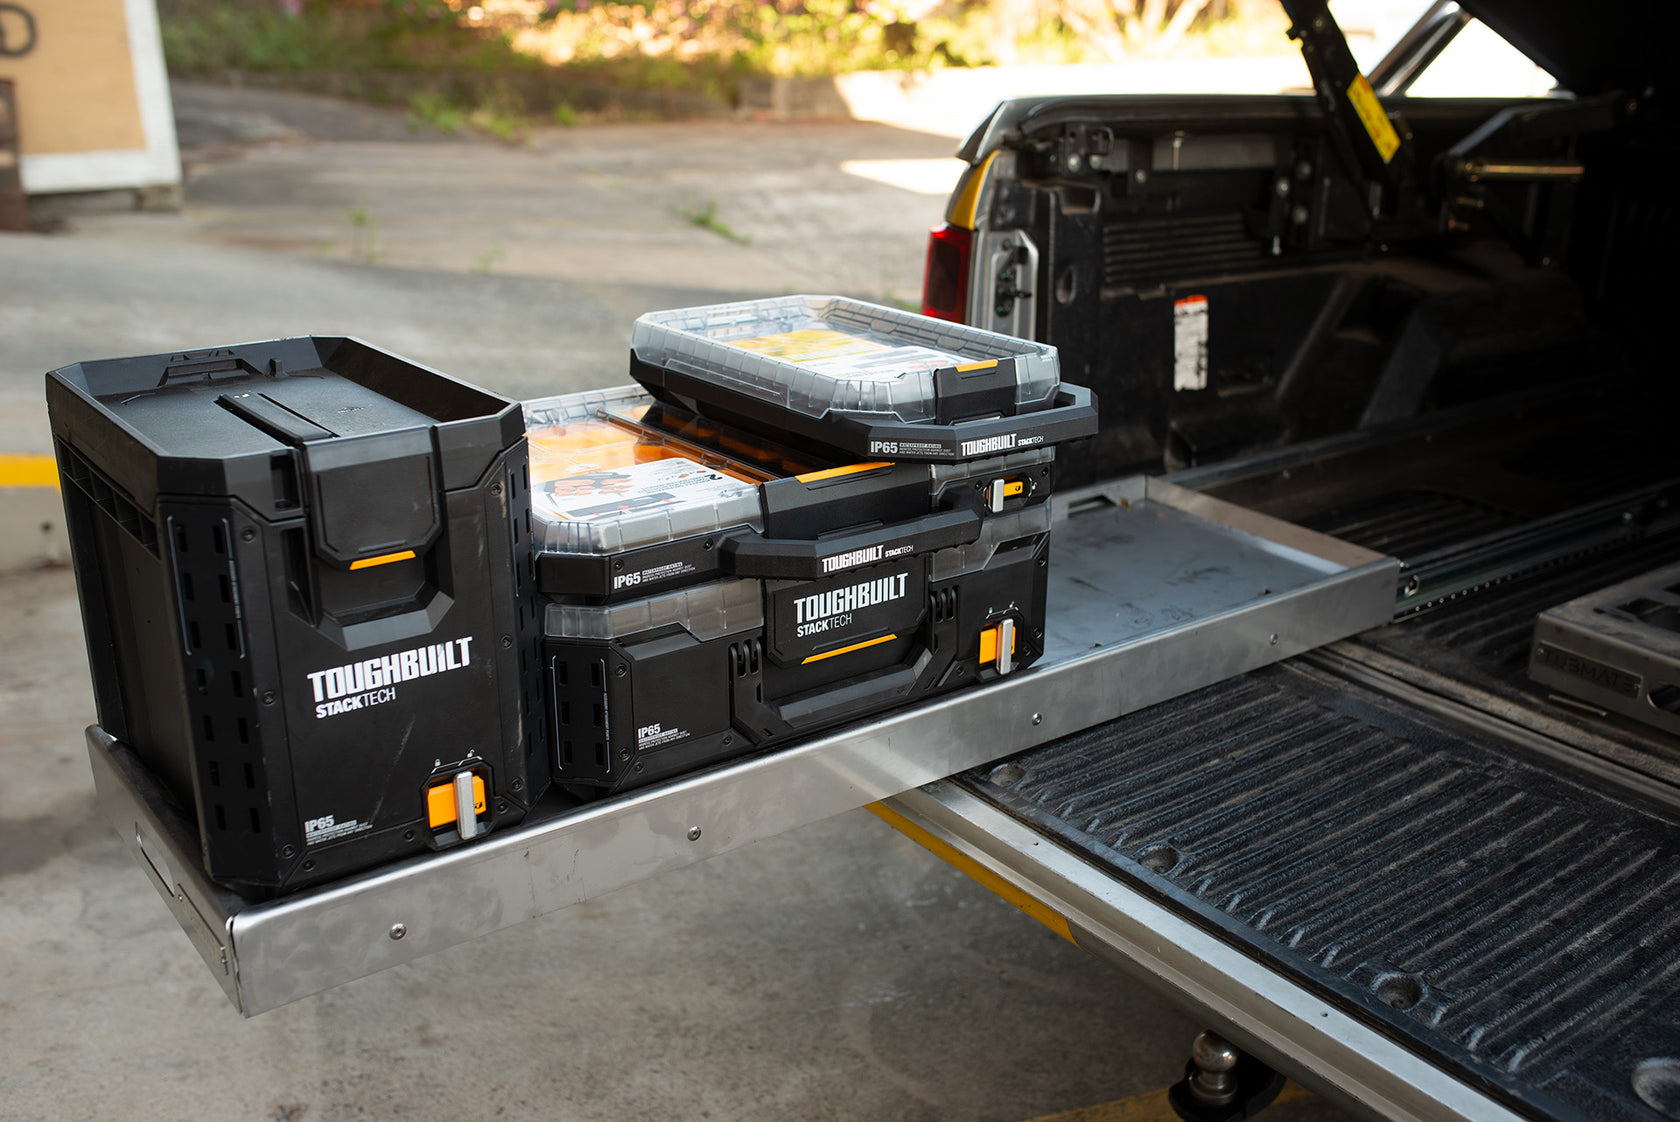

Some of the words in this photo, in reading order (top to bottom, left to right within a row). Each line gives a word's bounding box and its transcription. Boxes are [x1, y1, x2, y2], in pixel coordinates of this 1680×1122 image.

[870, 441, 898, 454] IP65
[961, 433, 1017, 456] TOUGHBUILT
[1017, 435, 1044, 447] STACKTECH
[822, 544, 884, 573] TOUGHBUILT
[884, 544, 914, 558] STACKTECH
[613, 572, 642, 590] IP65
[793, 572, 908, 624] TOUGHBUILT
[796, 613, 853, 638] STACKTECH
[306, 636, 473, 702] TOUGHBUILT
[315, 686, 397, 719] STACKTECH
[637, 722, 661, 739] IP65
[304, 814, 335, 833] IP65
